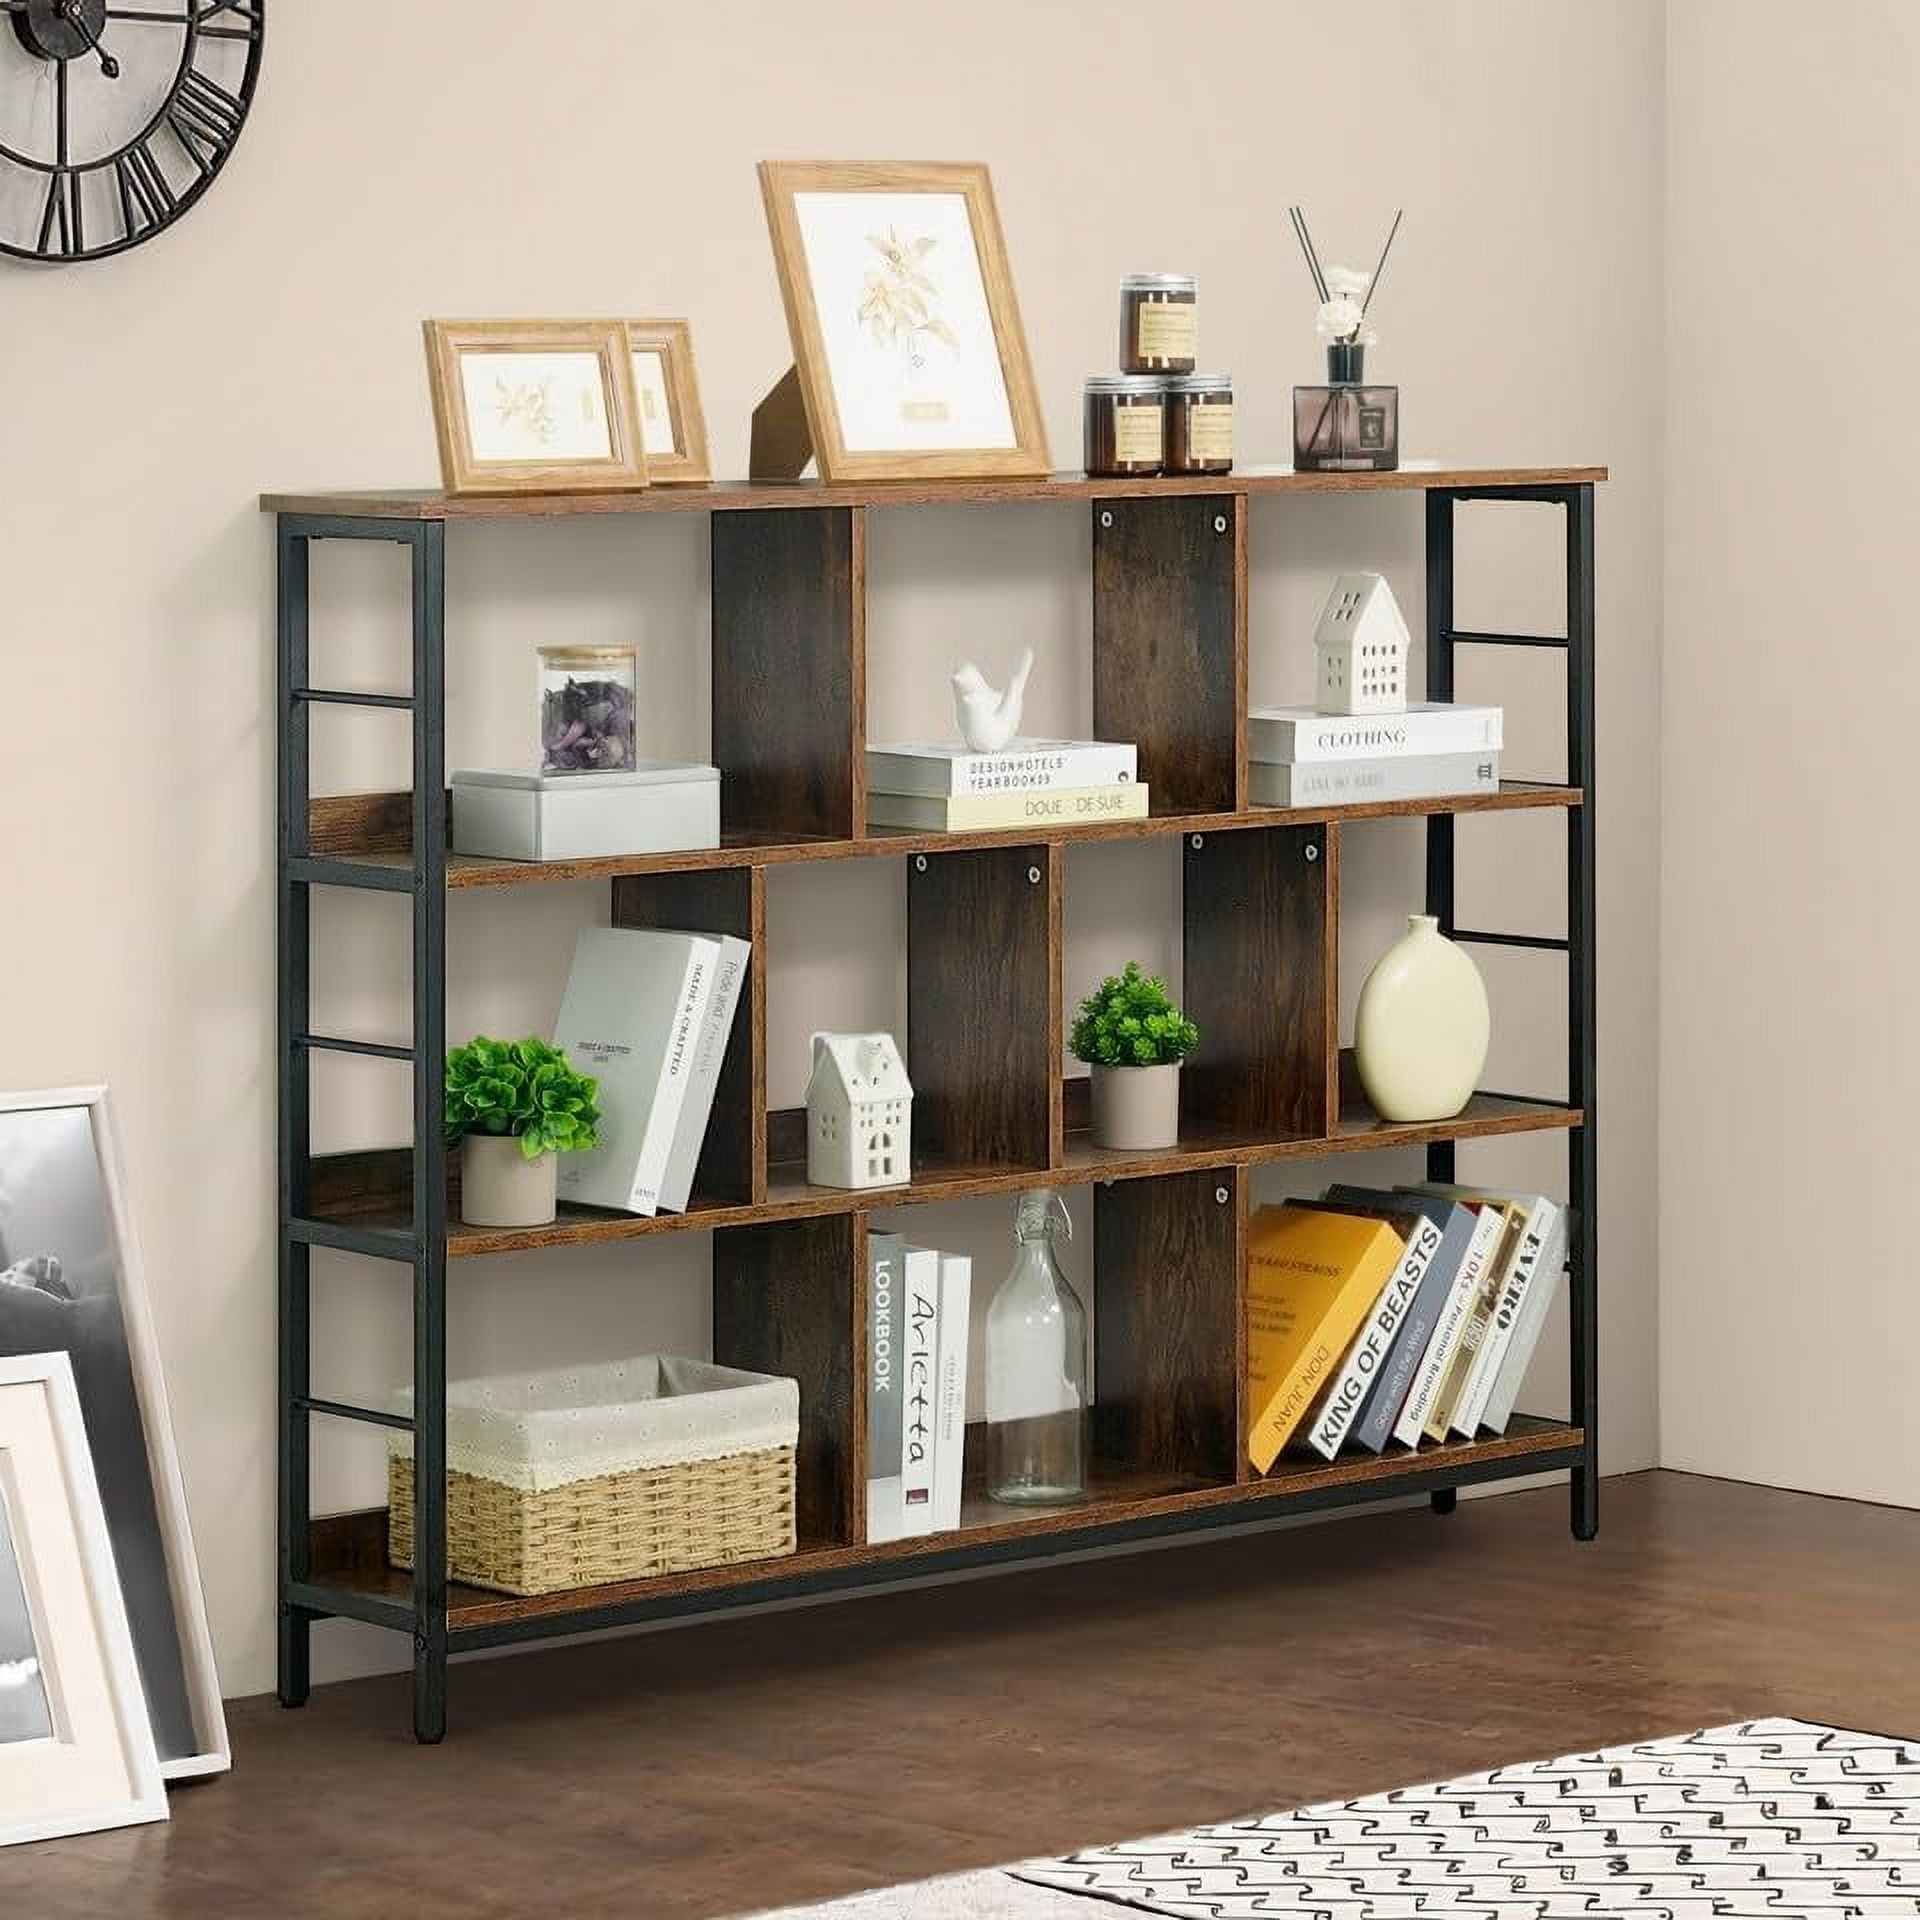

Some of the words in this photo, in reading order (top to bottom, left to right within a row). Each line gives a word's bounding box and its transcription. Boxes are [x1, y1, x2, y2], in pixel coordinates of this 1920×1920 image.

[1318, 729, 1407, 748] CLOTHING
[875, 1260, 891, 1393] LOOKBOOK
[1318, 1376, 1362, 1449] KING
[1357, 1333, 1381, 1375] OF
[1378, 1227, 1439, 1336] BEASTS
[1272, 1386, 1306, 1432] JUAN
